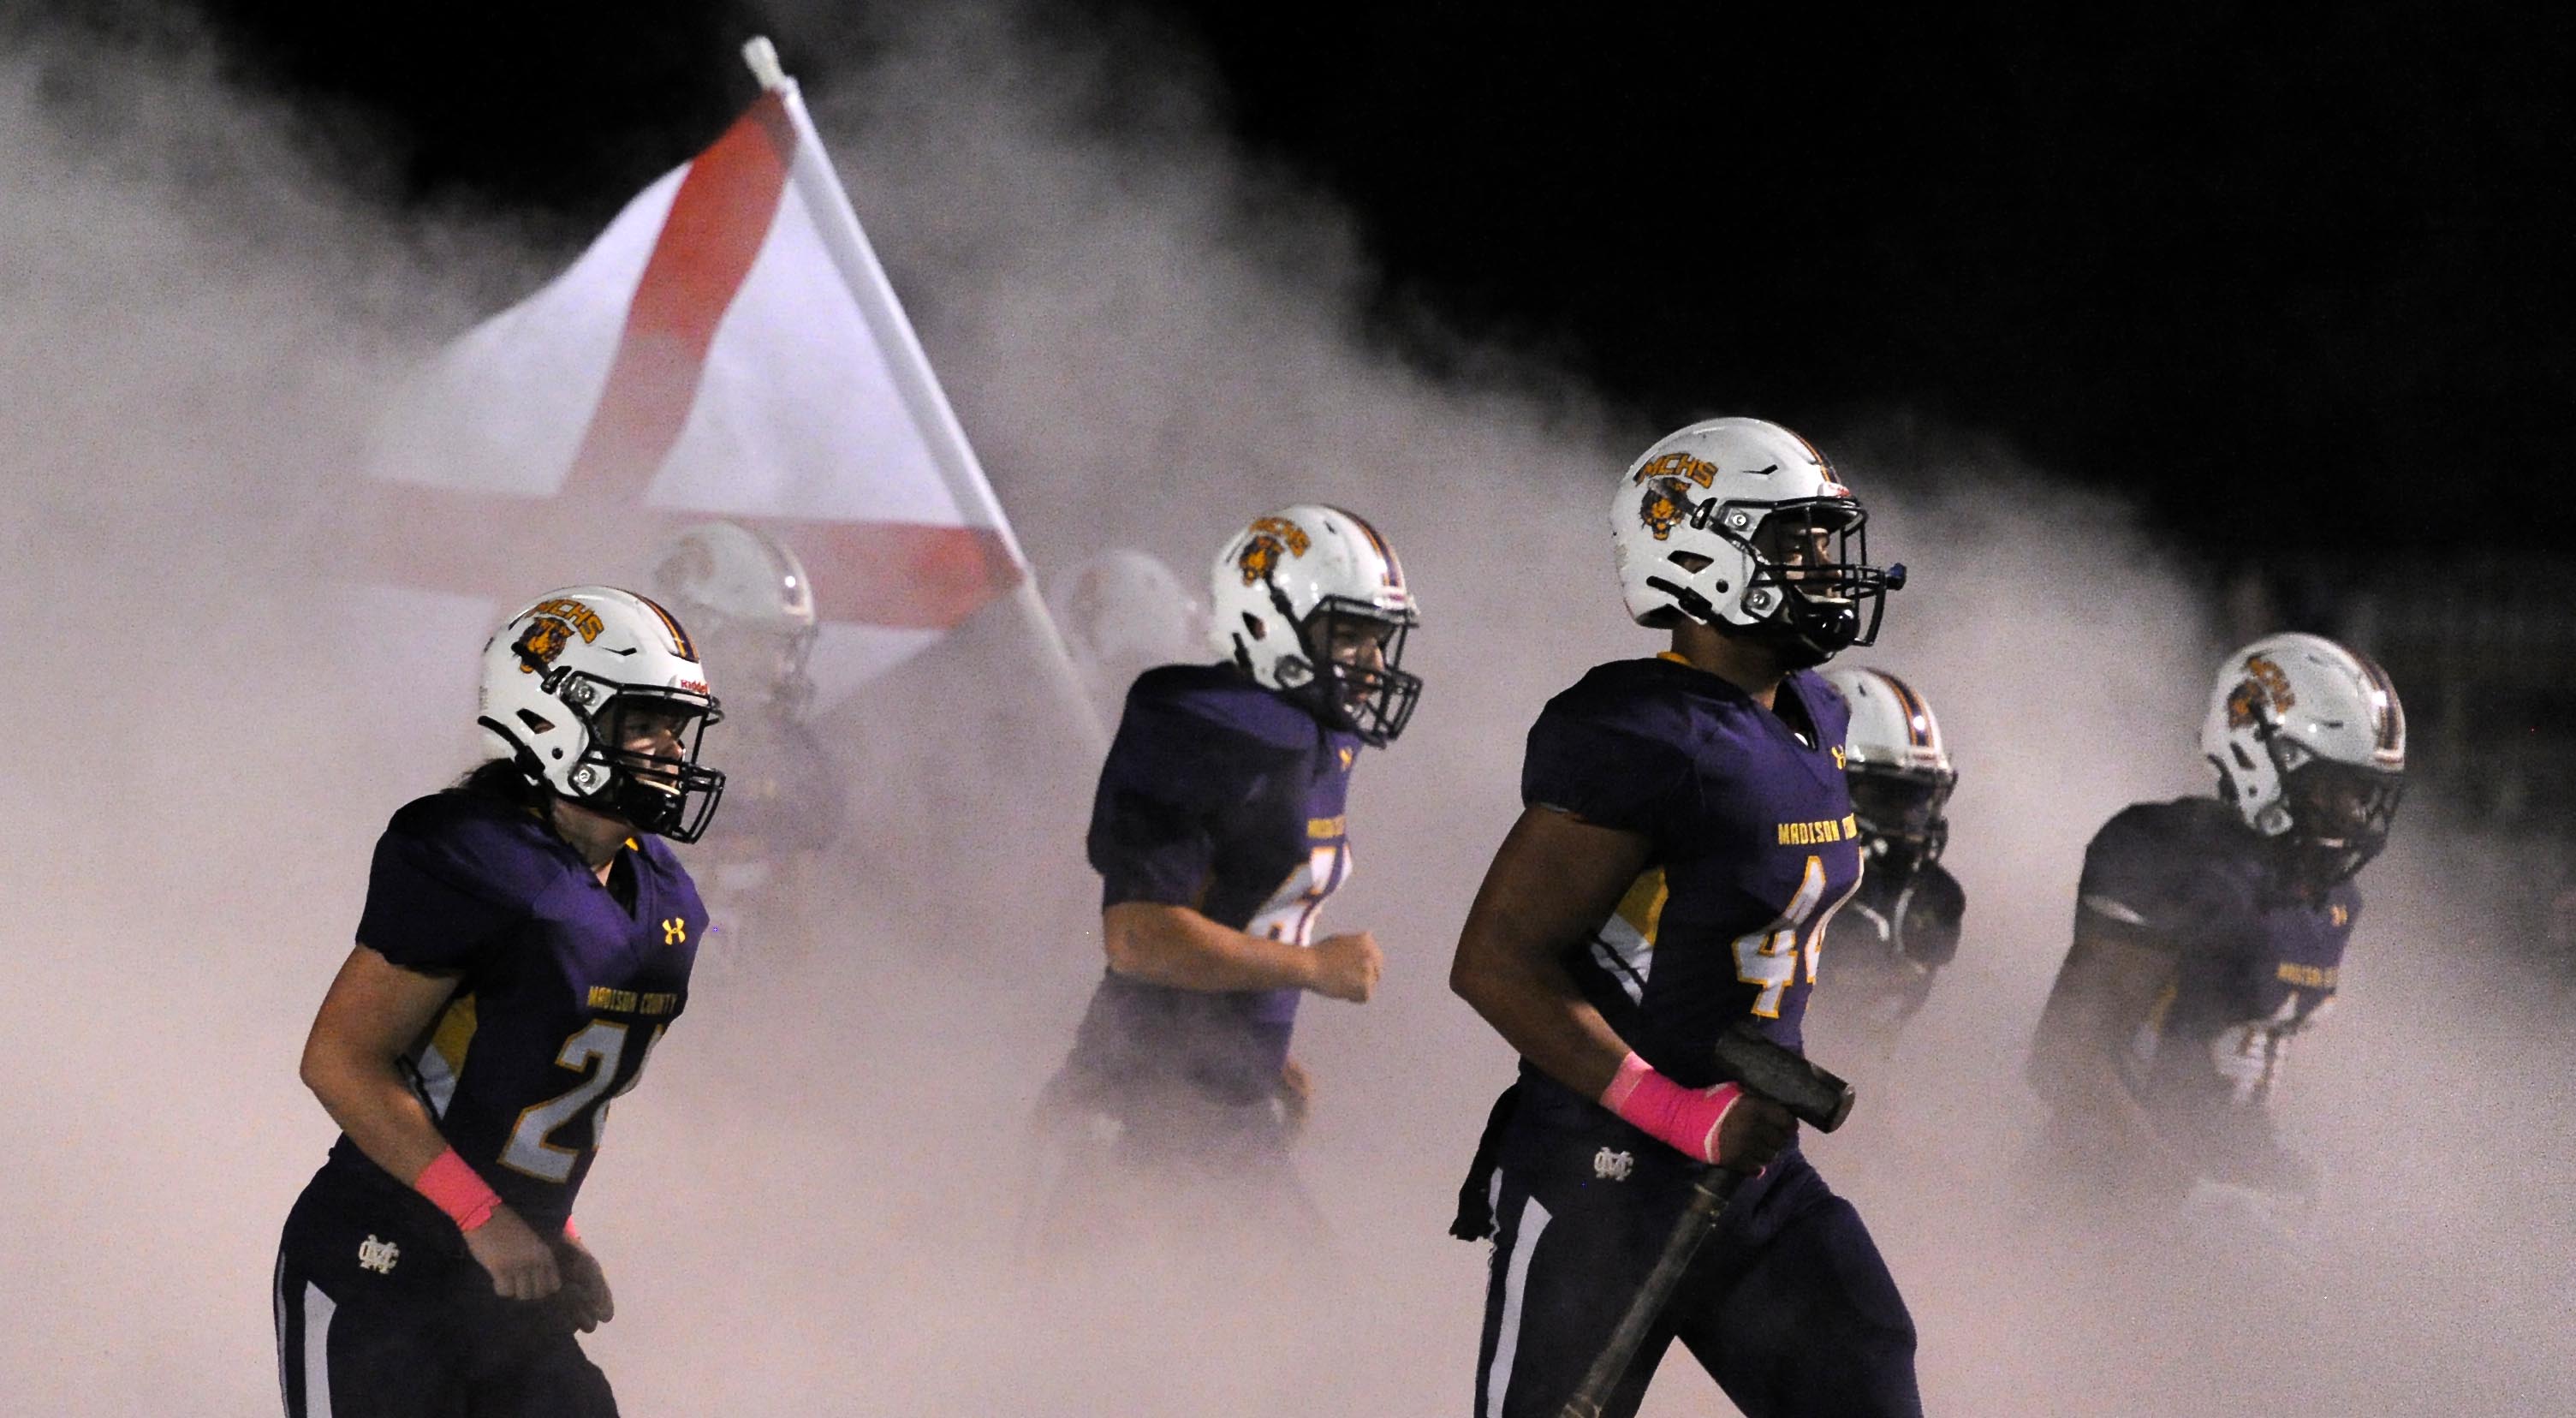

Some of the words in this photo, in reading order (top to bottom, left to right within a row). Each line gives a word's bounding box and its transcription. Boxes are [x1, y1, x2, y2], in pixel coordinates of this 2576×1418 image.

[1635, 451, 1718, 489] MCHS
[1777, 819, 1841, 846] MADISON
[586, 986, 639, 1013] MADISON
